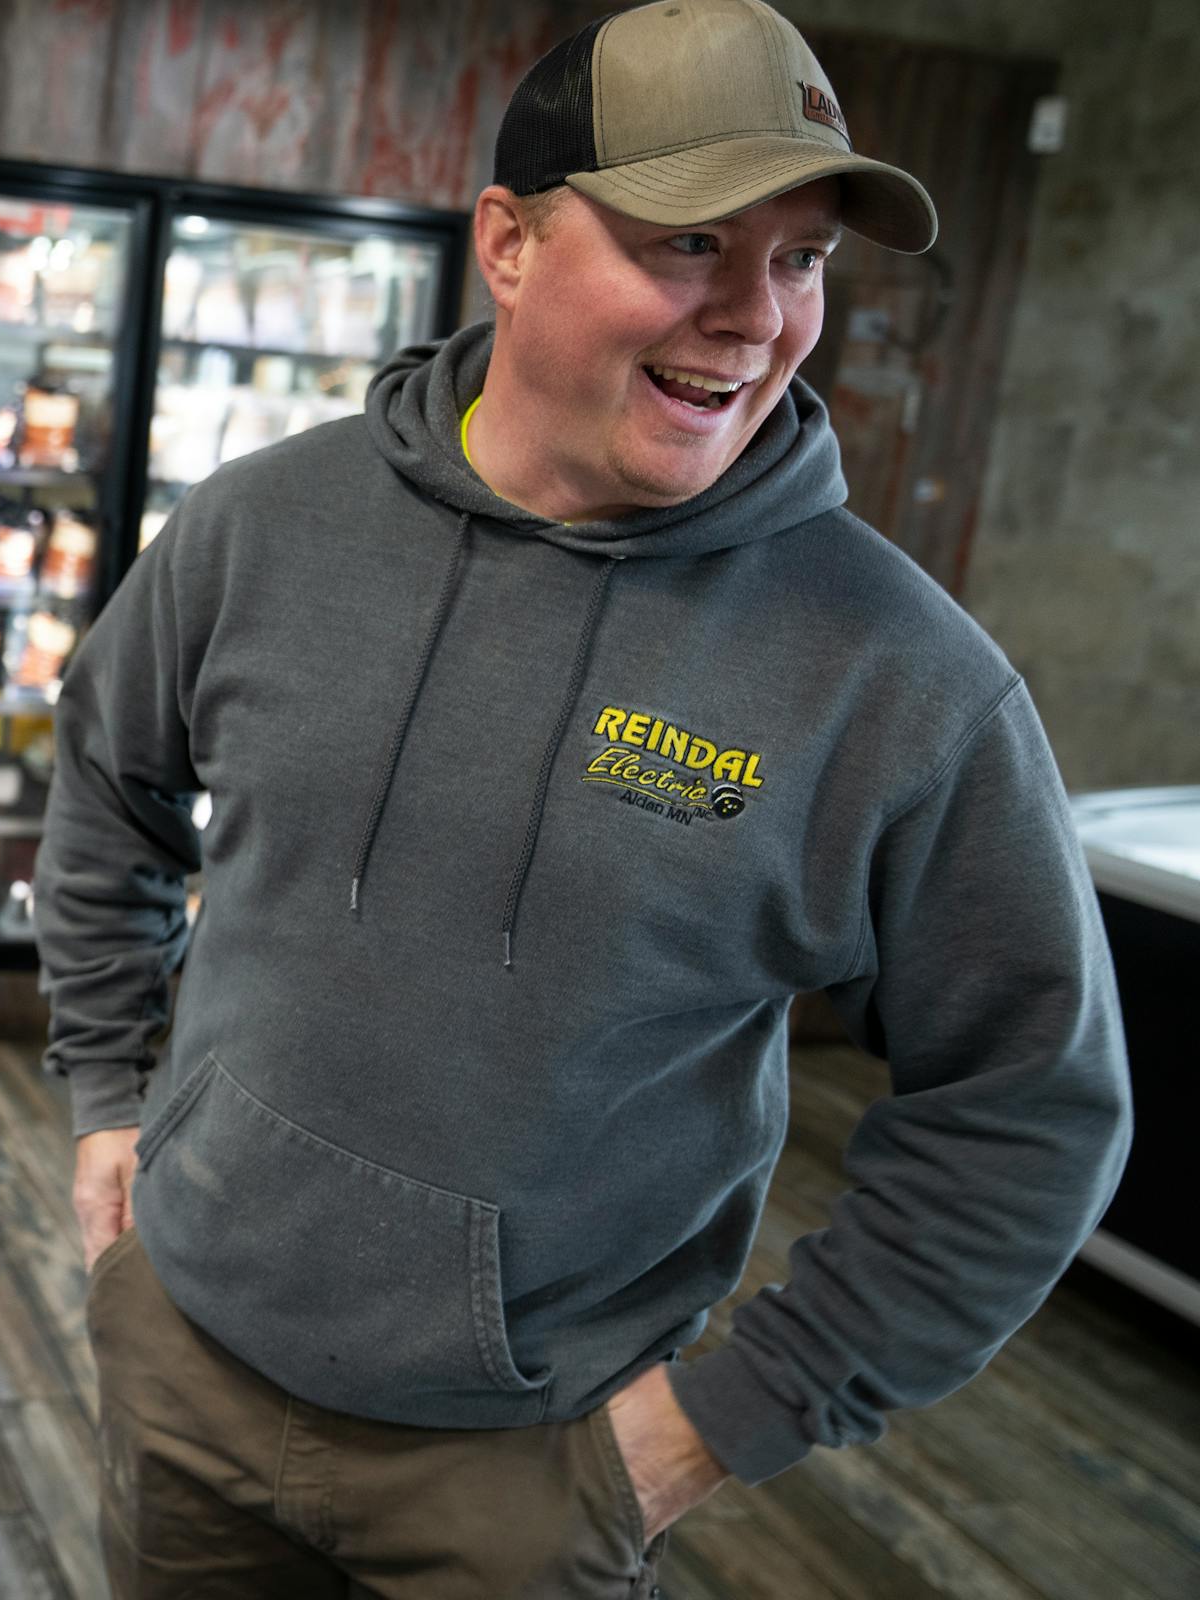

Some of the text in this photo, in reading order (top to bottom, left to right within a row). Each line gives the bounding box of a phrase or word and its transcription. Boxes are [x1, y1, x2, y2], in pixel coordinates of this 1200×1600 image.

[586, 747, 708, 801] Electric
[593, 705, 765, 789] REINDAL
[666, 806, 693, 826] MN
